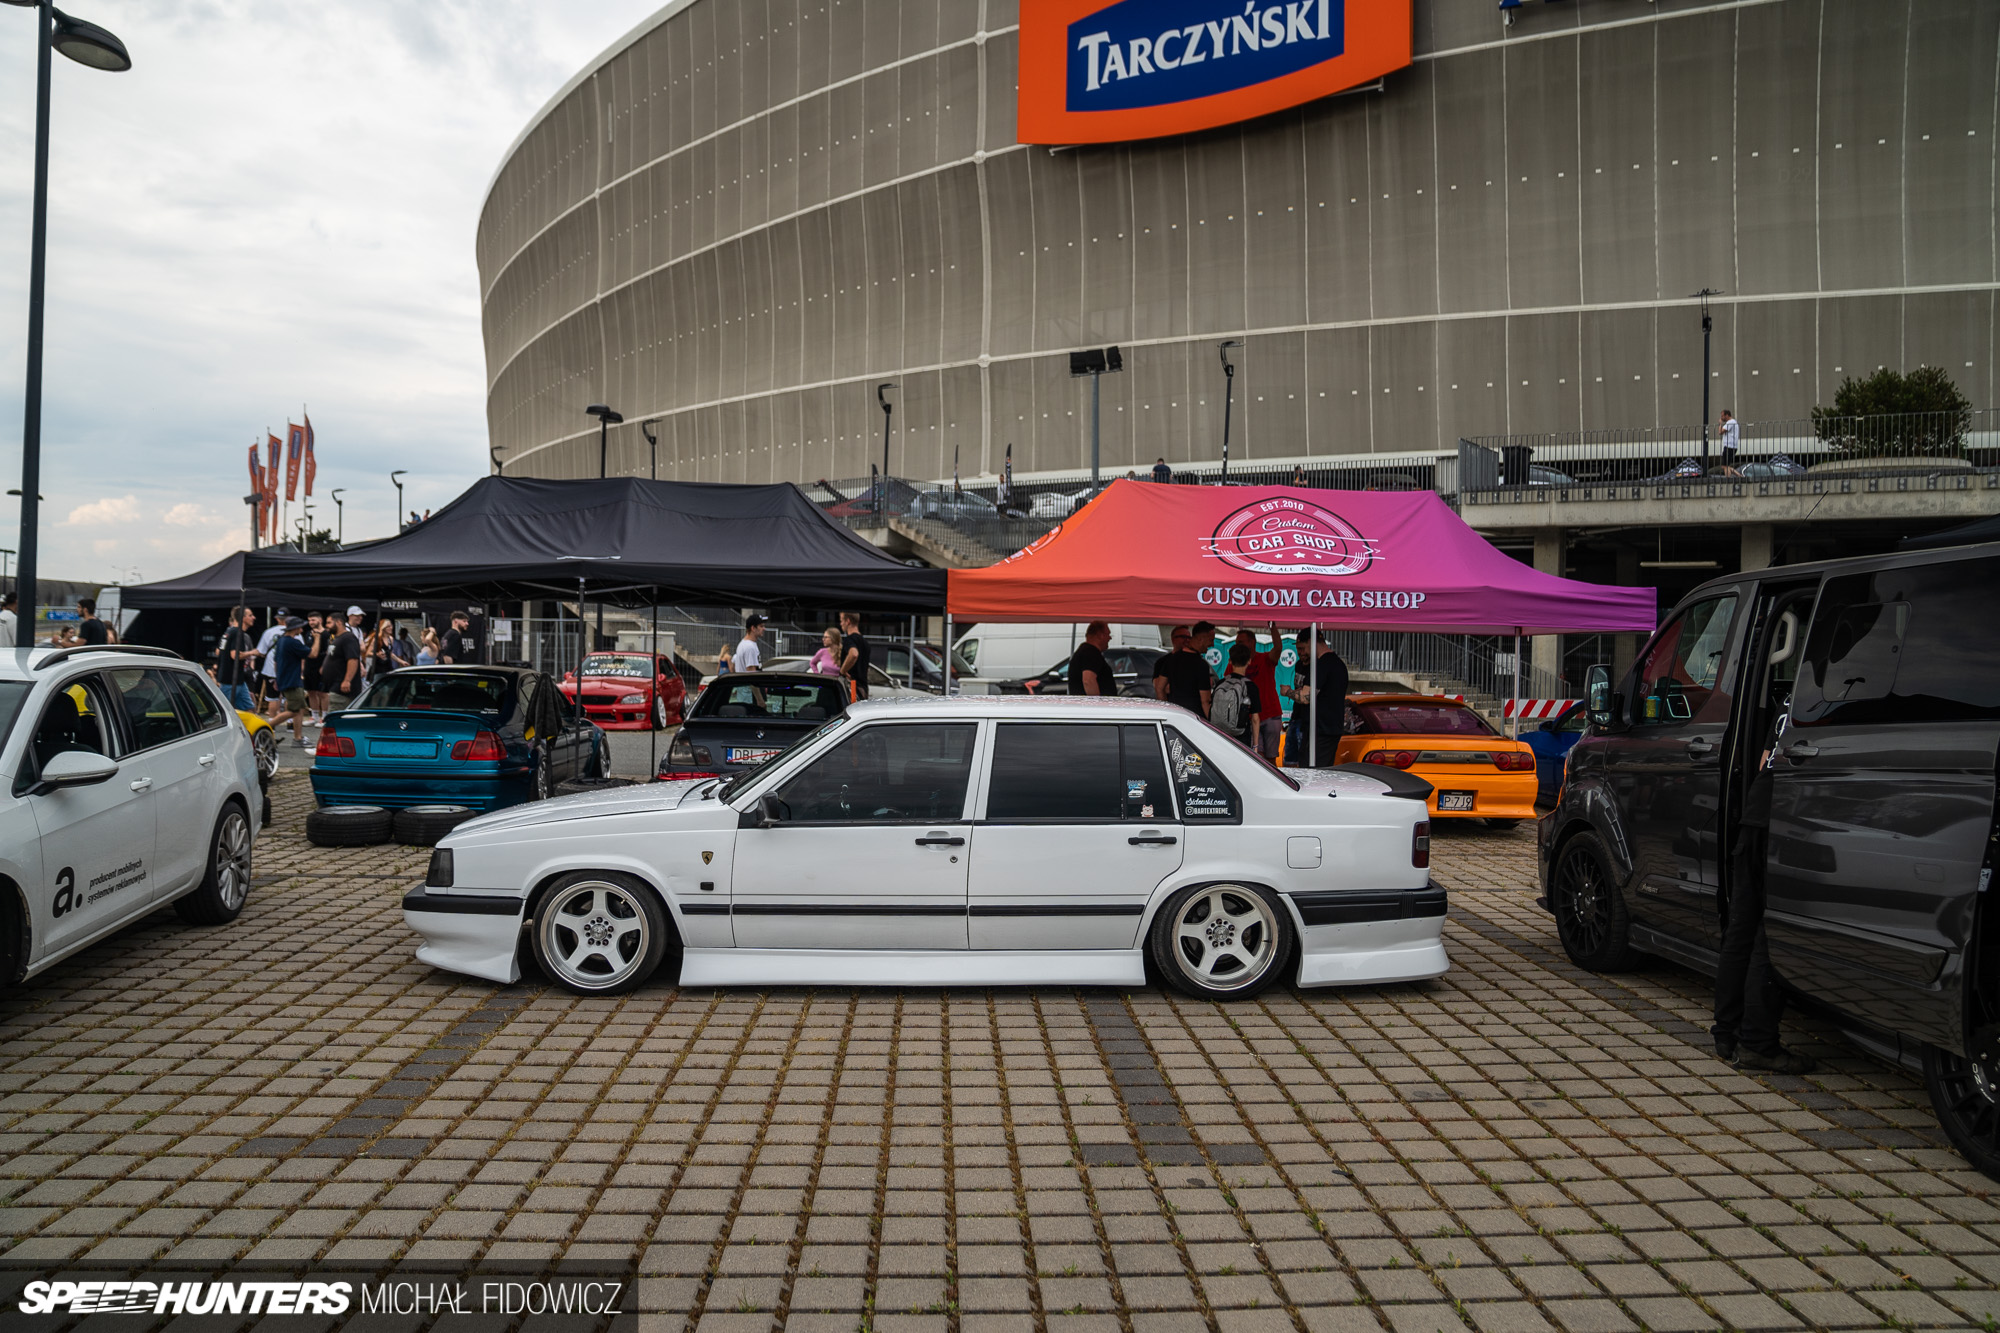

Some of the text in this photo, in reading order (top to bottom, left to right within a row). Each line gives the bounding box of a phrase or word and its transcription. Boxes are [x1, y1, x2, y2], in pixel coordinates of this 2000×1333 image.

[1077, 0, 1331, 92] TARCZYŃSKI
[1260, 499, 1304, 512] EST.2010
[1262, 517, 1316, 531] Custom
[1249, 534, 1337, 551] CAR SHOP
[1301, 566, 1329, 574] ABOUT
[1197, 586, 1426, 610] CUSTOM CAR SHOP
[610, 668, 643, 677] LEVEL
[734, 749, 757, 761] DBL
[89, 868, 117, 890] producent
